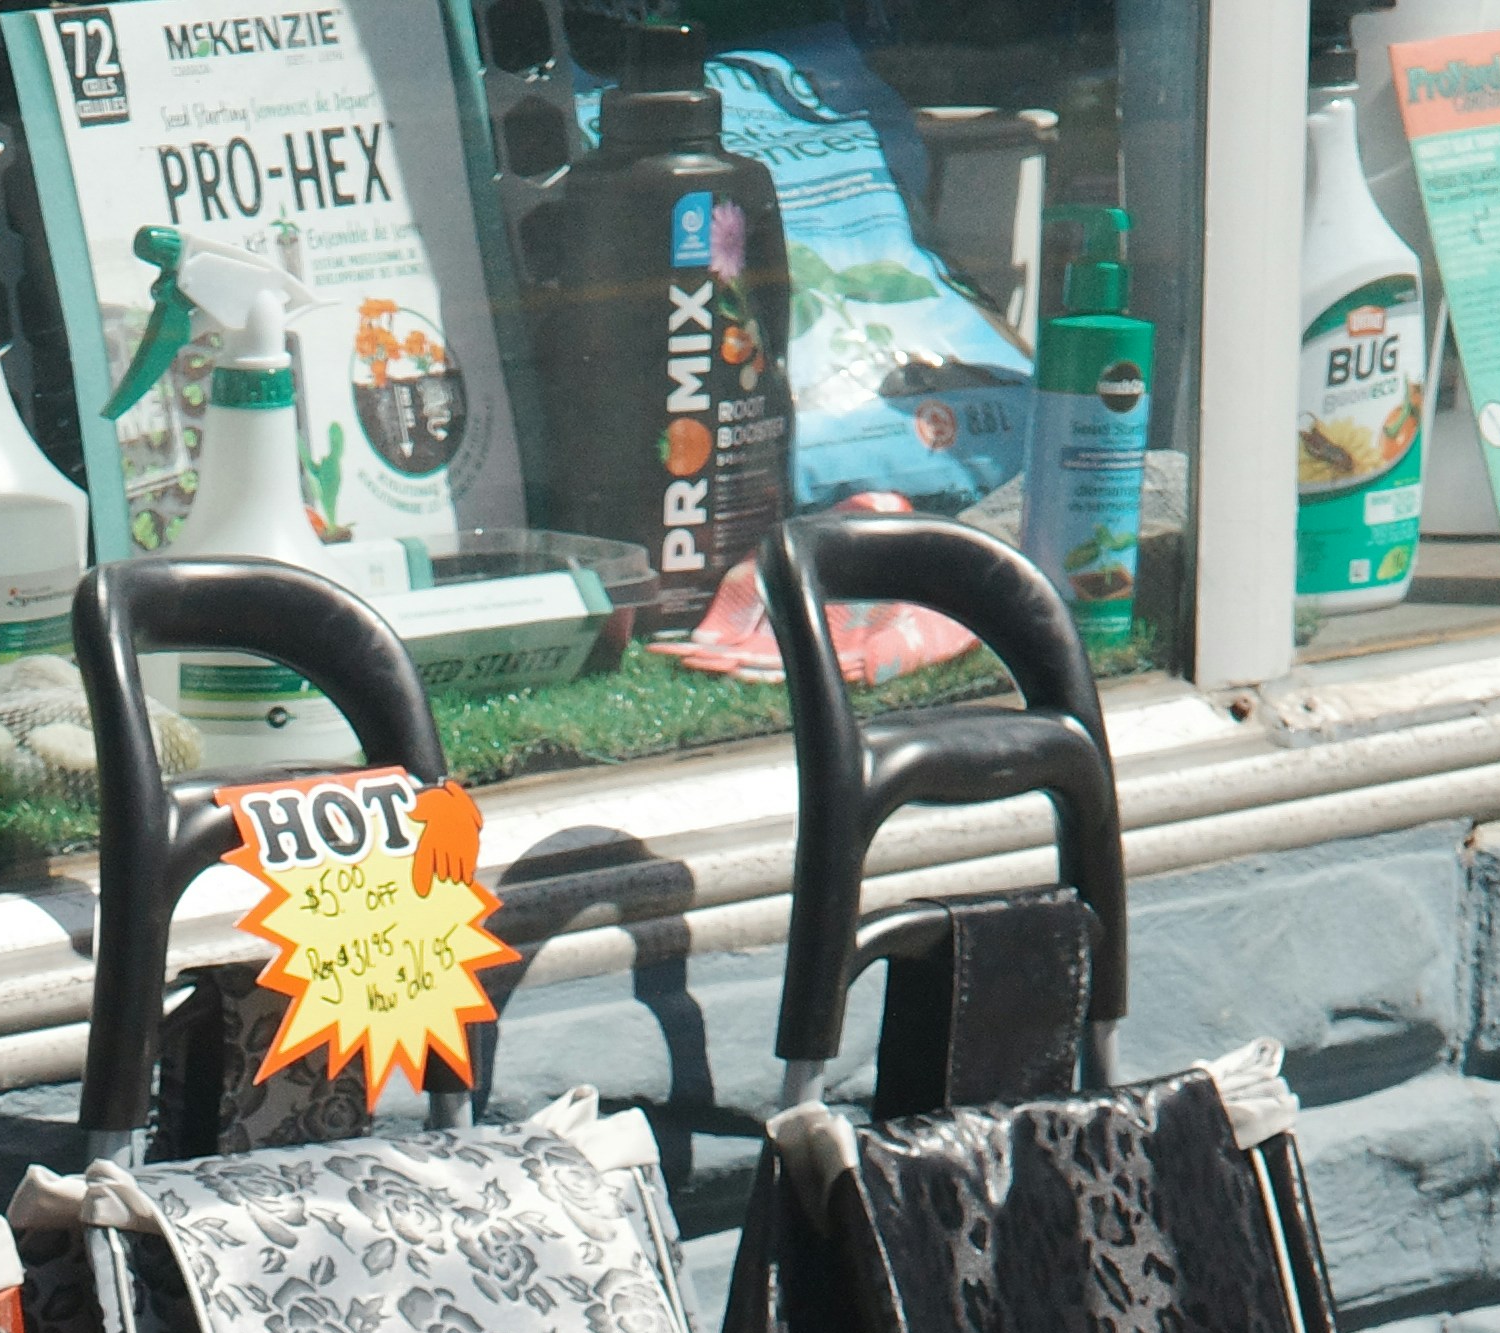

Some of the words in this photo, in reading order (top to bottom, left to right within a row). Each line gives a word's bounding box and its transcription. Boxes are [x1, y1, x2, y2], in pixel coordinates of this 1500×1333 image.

[60, 19, 120, 79] 72
[158, 122, 392, 225] PRO-HEX
[1327, 335, 1400, 387] BUG
[247, 782, 416, 862] HOT
